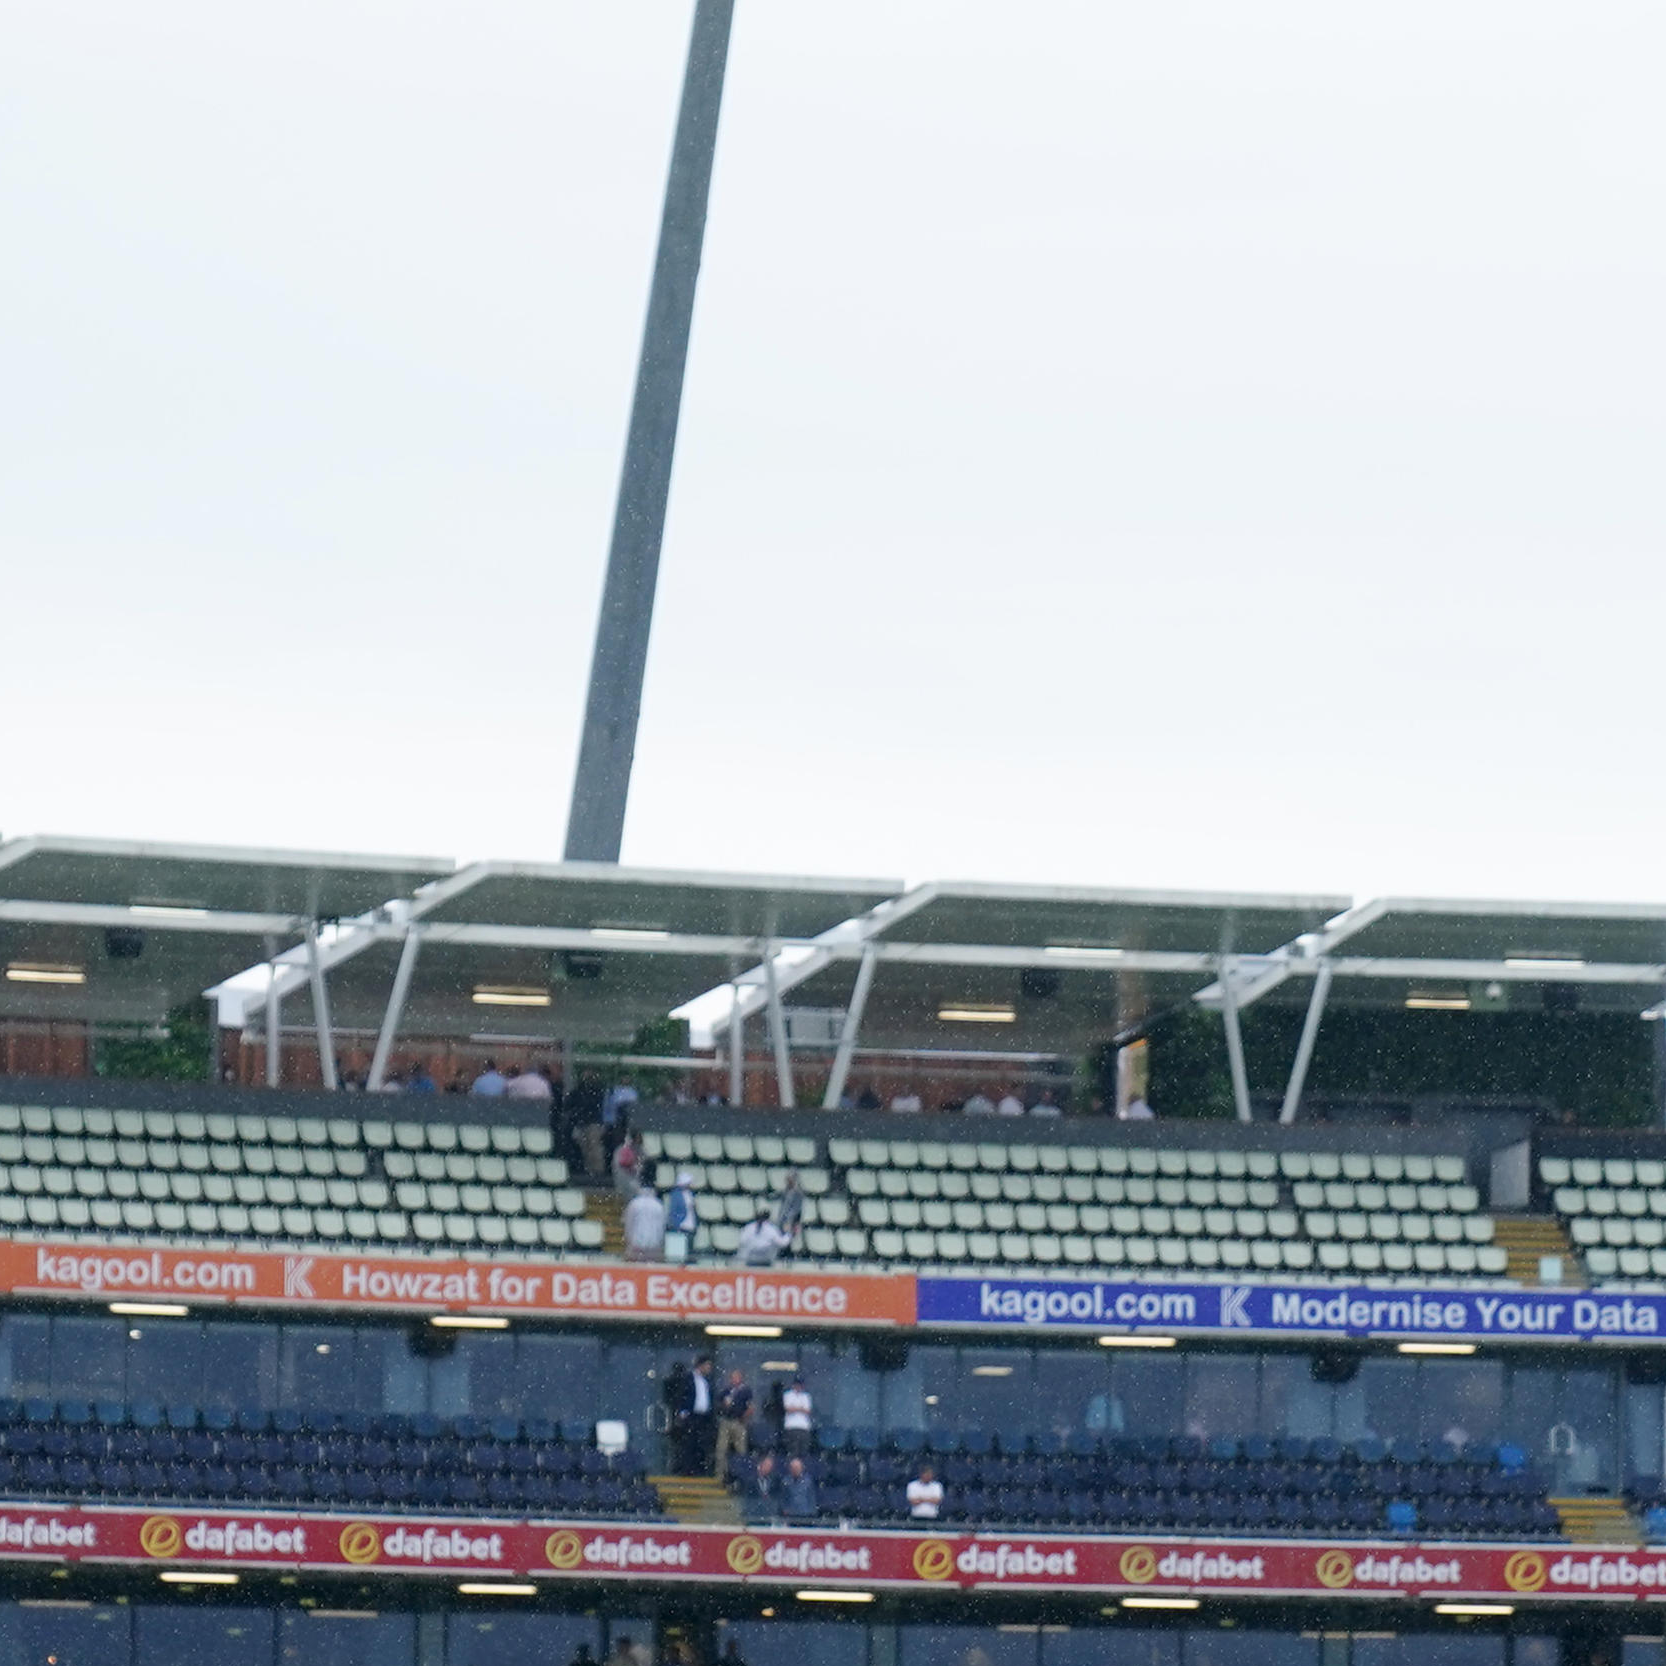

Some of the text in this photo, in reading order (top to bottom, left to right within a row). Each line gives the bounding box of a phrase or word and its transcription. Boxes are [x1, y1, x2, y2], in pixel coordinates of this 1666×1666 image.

[36, 1249, 254, 1290] kagool.com
[342, 1265, 479, 1300] Howzat
[488, 1269, 541, 1302] for
[552, 1273, 637, 1307] Data
[647, 1276, 847, 1313] Excellence
[980, 1283, 1195, 1323] kagool.com
[1271, 1293, 1466, 1329] Modernise
[1475, 1298, 1563, 1331] Your
[1573, 1301, 1658, 1333] Data
[185, 1520, 305, 1555] dafabet
[385, 1527, 502, 1562] dafabet
[584, 1536, 690, 1567] dafabet
[765, 1540, 870, 1571] dafabet
[957, 1544, 1077, 1579] dafabet
[1158, 1551, 1263, 1582] dafabet
[1355, 1555, 1460, 1586] dafabet
